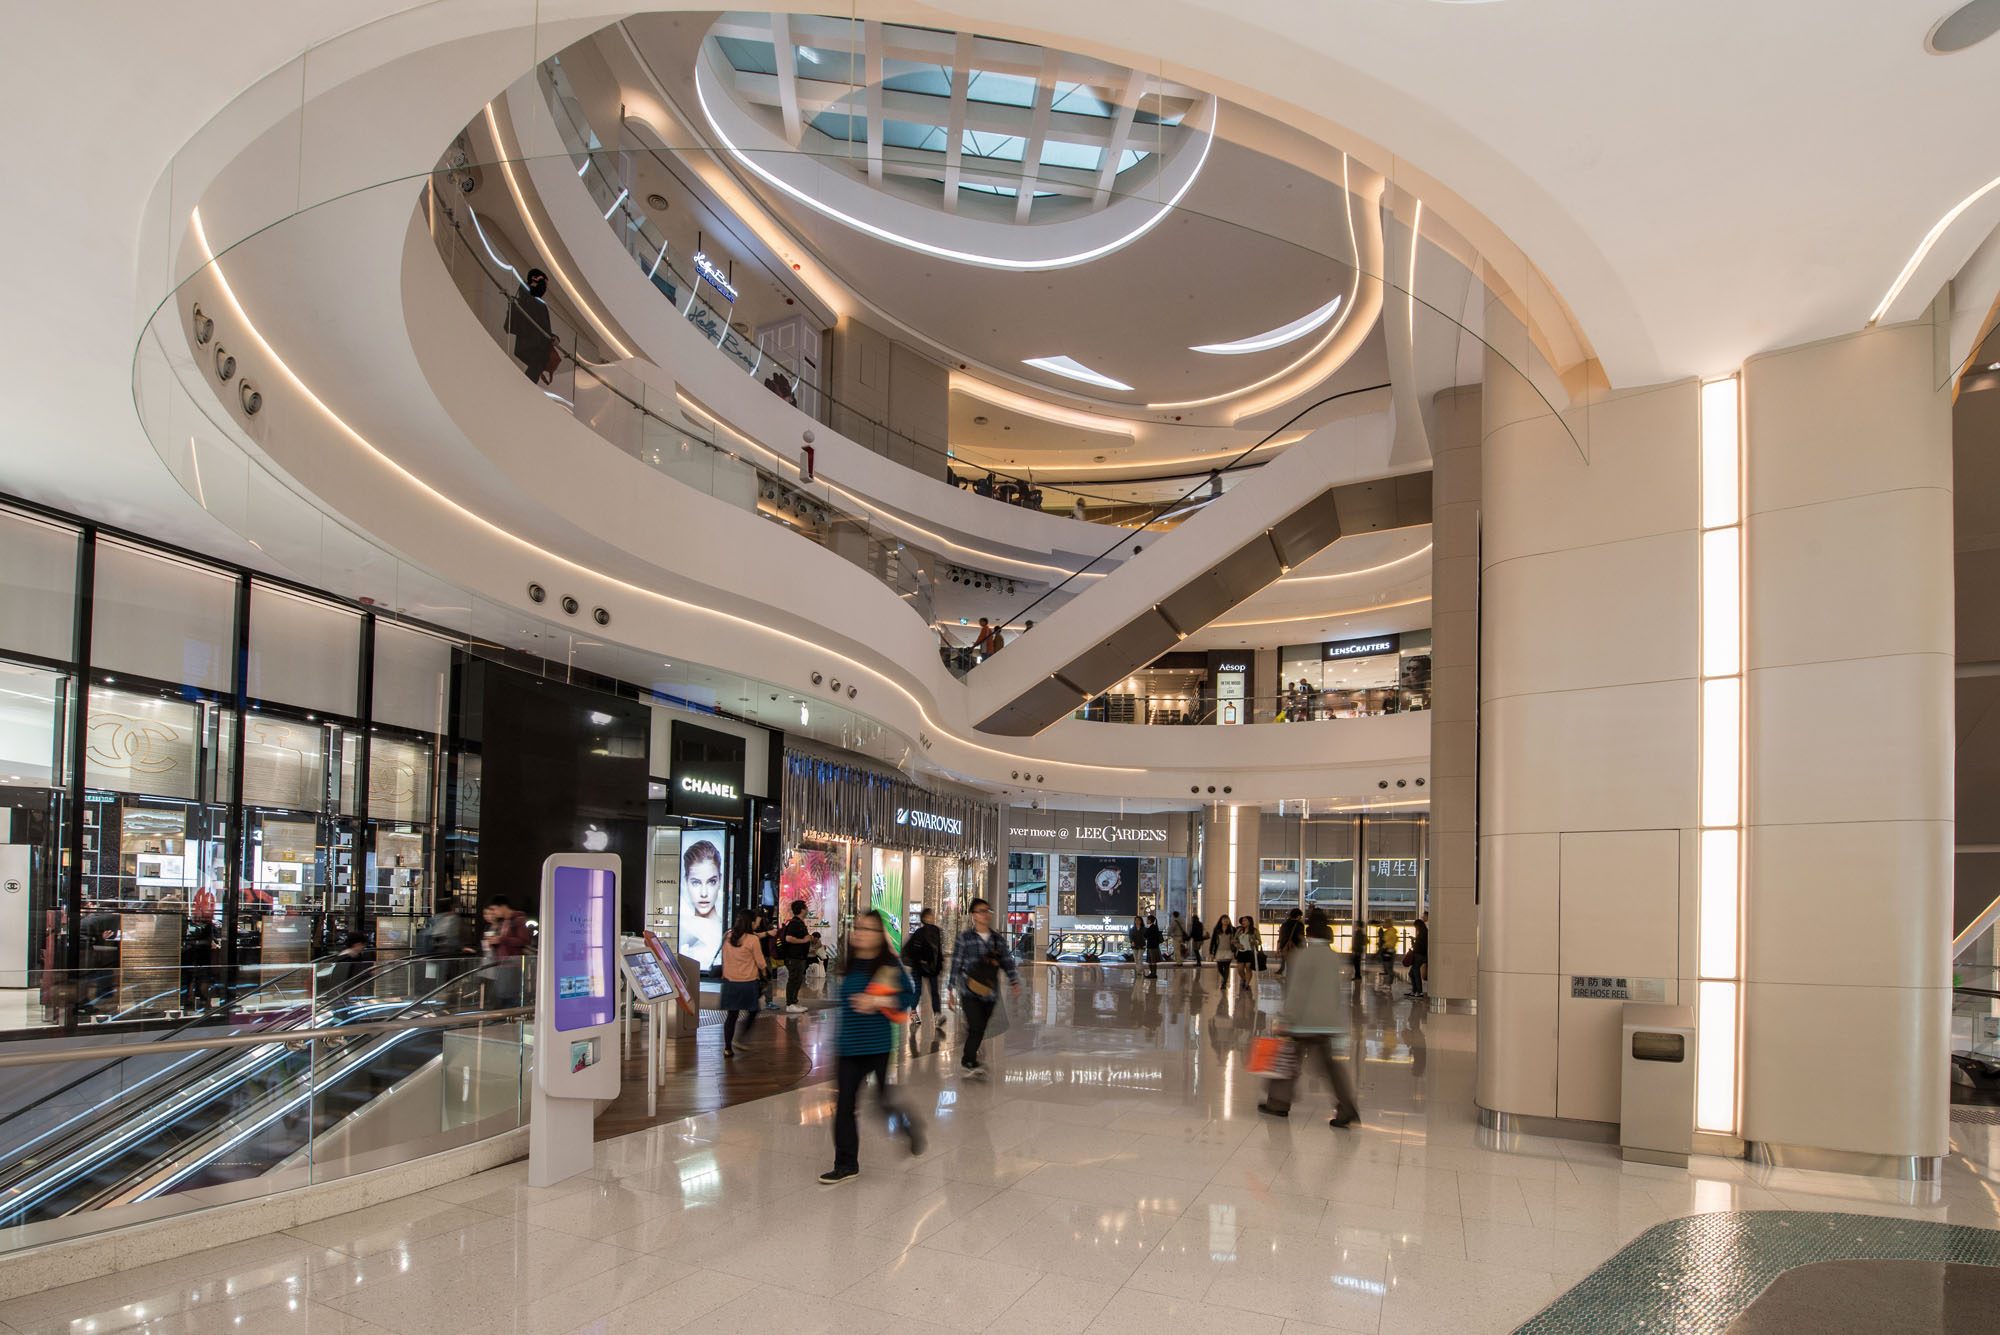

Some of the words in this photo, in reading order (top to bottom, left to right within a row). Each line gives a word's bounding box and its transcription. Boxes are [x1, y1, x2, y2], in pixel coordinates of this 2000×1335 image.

[682, 777, 738, 799] CHANEL
[911, 810, 962, 835] SWAROVSKI
[1030, 828, 1056, 837] more
[1058, 828, 1069, 839] @
[1574, 988, 1589, 997] FIRE
[1590, 989, 1610, 998] HOSE
[1611, 989, 1629, 999] REEL
